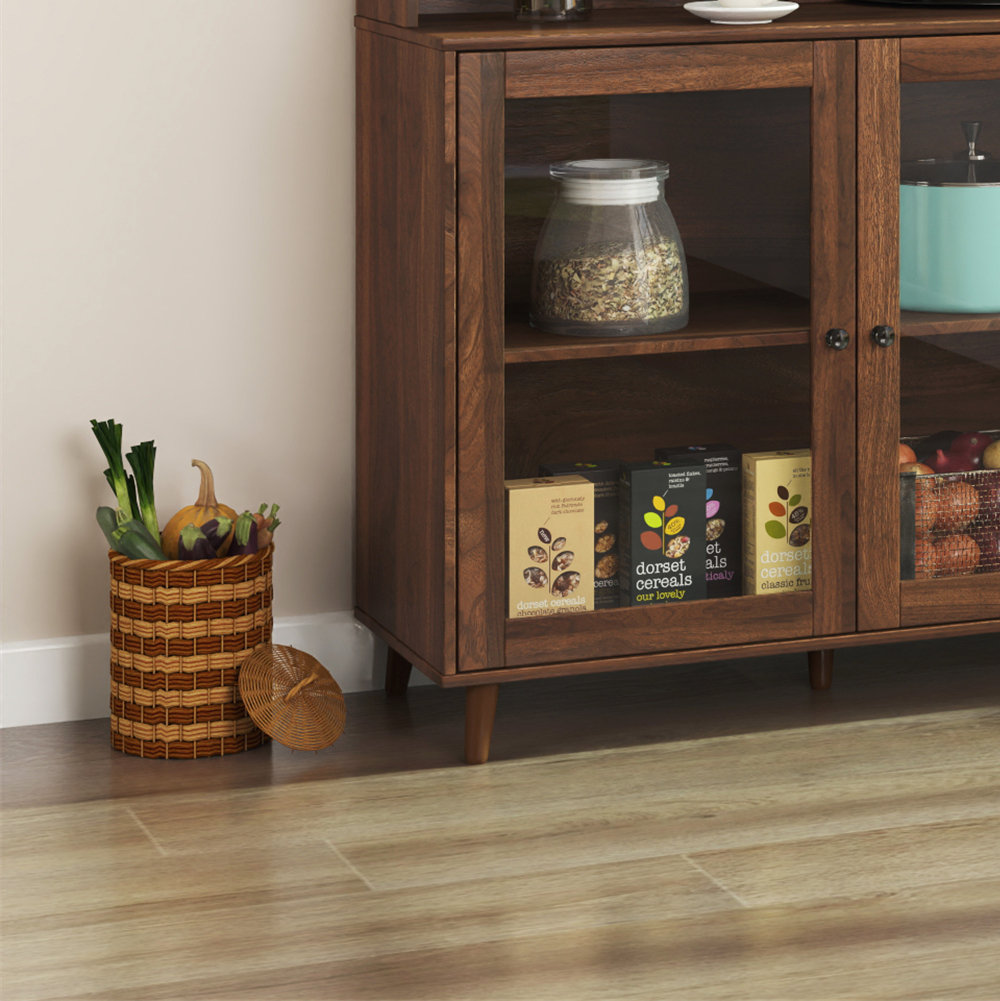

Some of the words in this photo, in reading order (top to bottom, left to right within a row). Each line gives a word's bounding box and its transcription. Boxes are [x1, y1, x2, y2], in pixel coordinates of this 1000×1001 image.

[706, 556, 727, 569] als
[760, 550, 811, 564] dorset
[636, 559, 687, 575] dorset
[636, 574, 693, 590] cereals
[705, 571, 735, 581] ticaly
[761, 580, 794, 590] classic
[796, 578, 811, 587] fru
[636, 592, 655, 602] our
[656, 589, 687, 601] lovely
[516, 600, 549, 610] dorset
[550, 596, 586, 608] cereals
